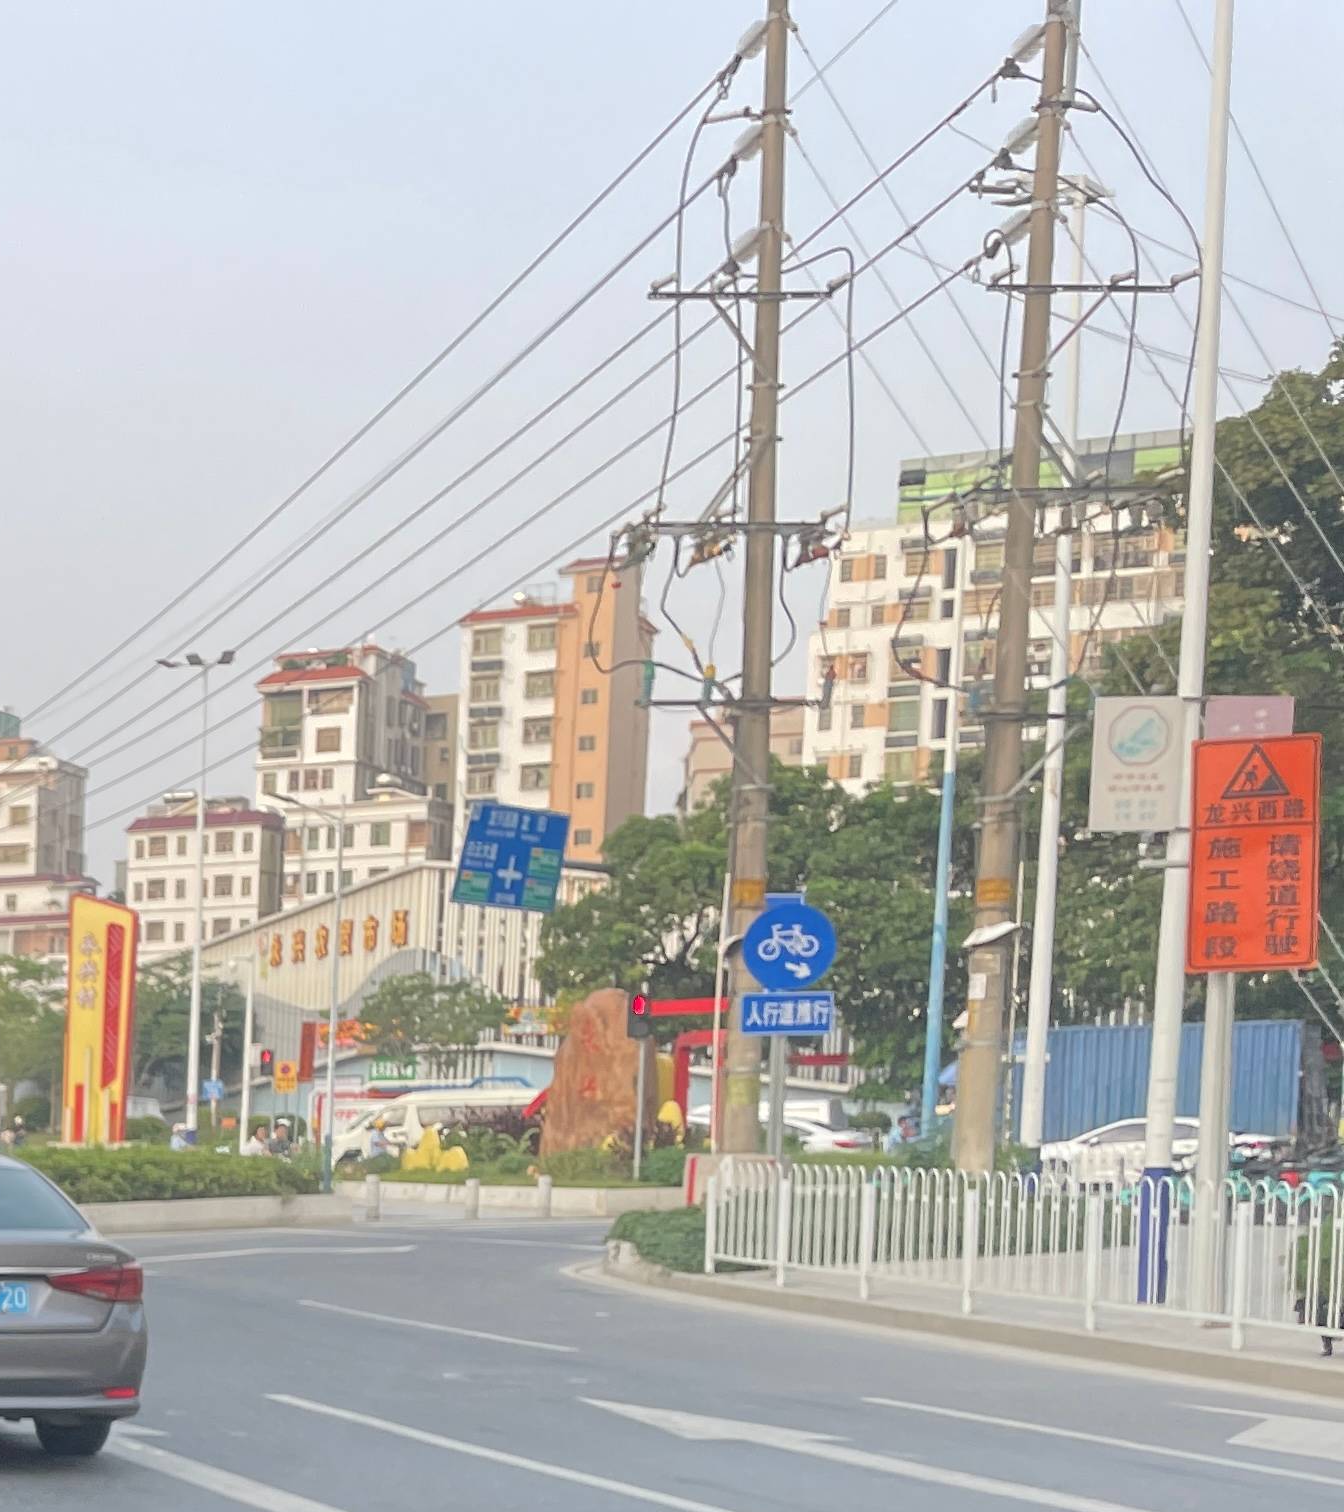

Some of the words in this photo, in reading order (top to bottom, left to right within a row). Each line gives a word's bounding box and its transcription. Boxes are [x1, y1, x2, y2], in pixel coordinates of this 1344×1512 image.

[1202, 798, 1307, 824] 龙兴西路
[1203, 837, 1242, 960] 施工路段
[1264, 834, 1302, 956] 请绕道行驶
